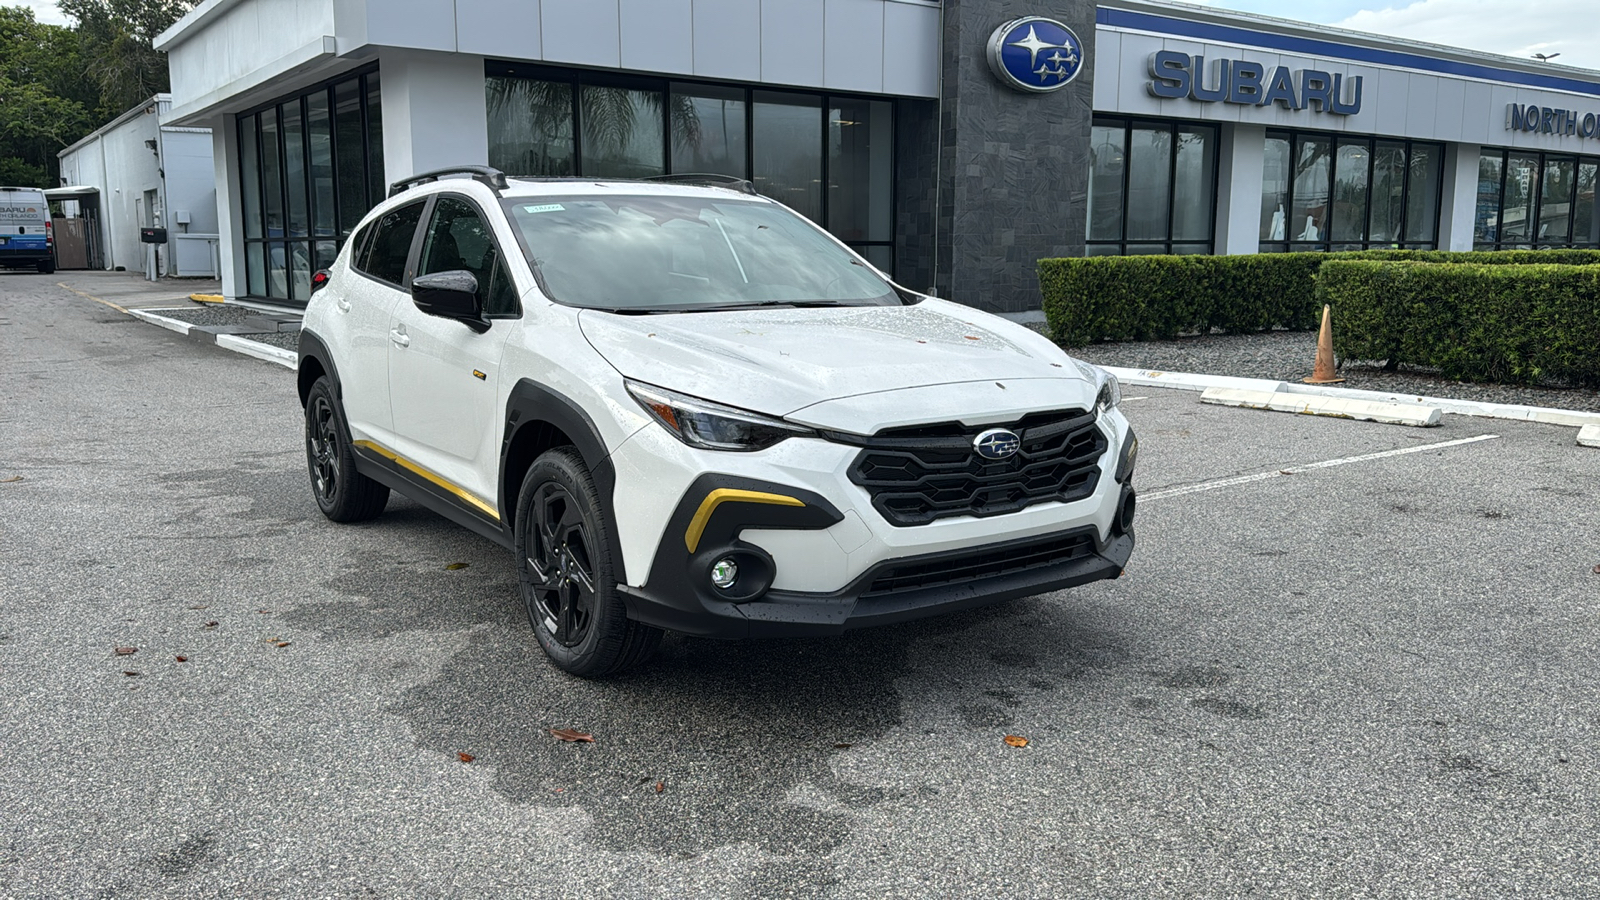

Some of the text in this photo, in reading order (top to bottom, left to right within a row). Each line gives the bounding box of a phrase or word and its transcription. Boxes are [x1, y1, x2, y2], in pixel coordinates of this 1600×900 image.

[1146, 50, 1364, 115] SUBARU
[1506, 103, 1600, 140] NORTH O
